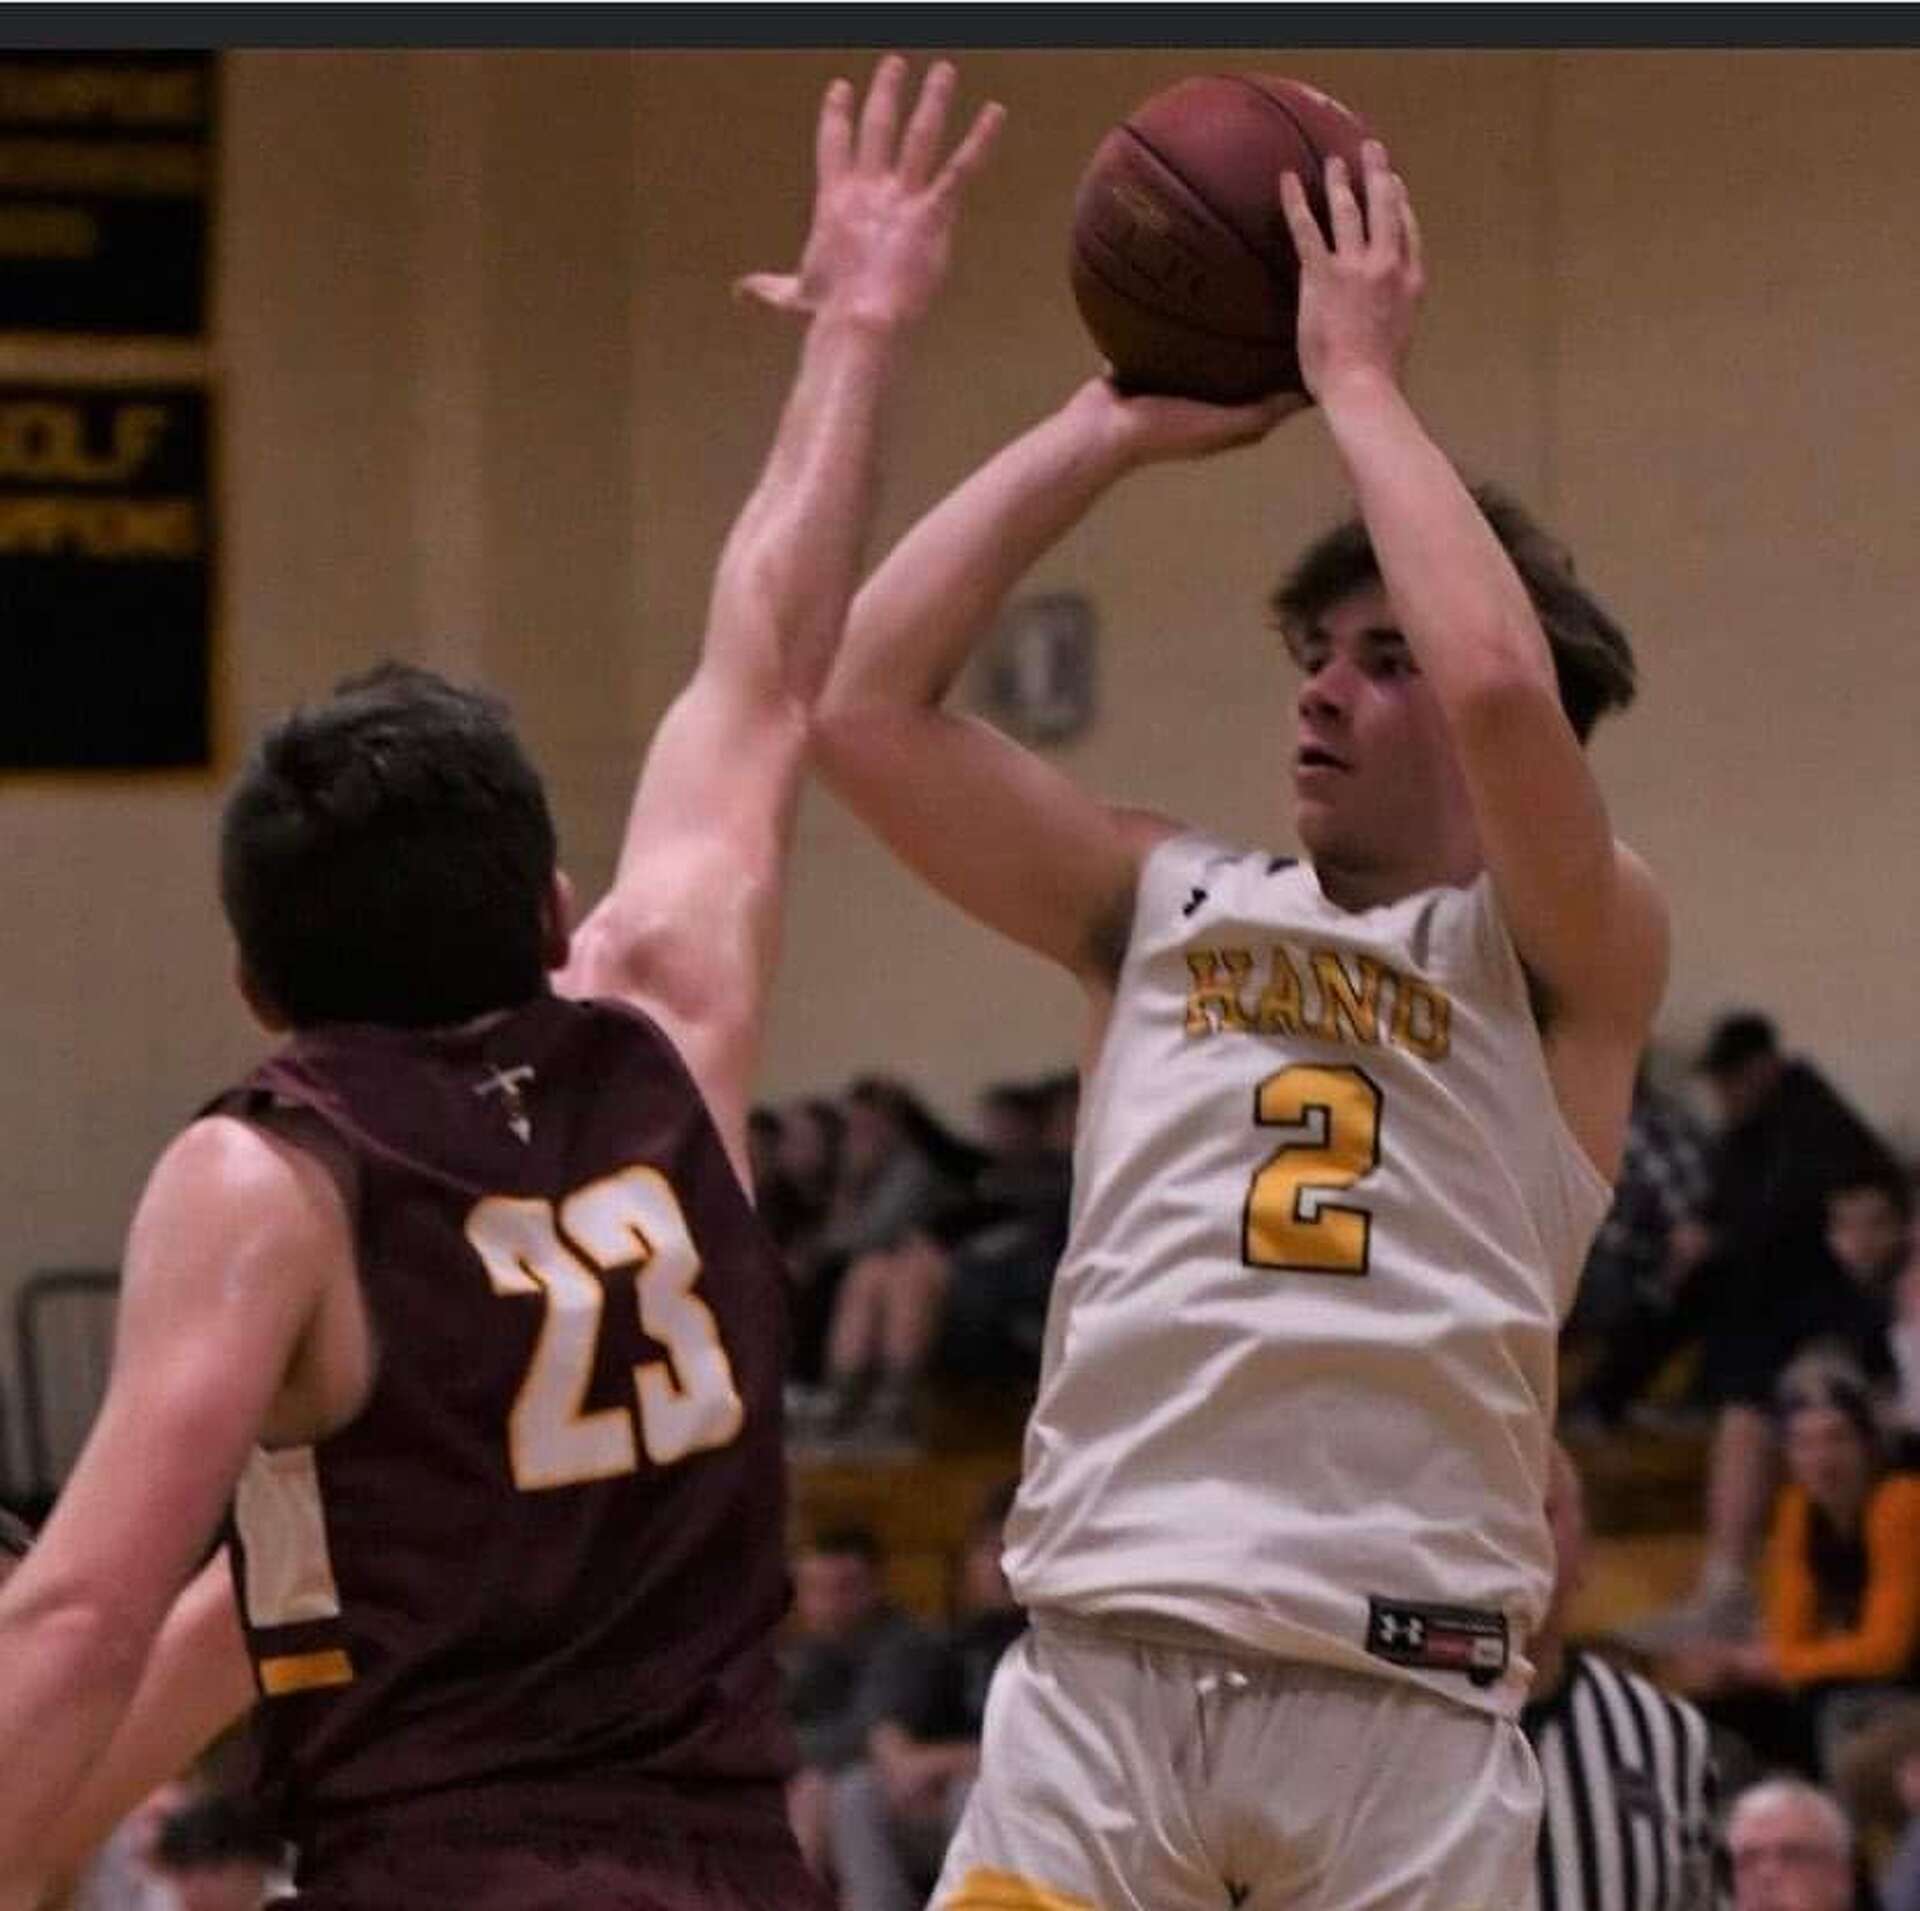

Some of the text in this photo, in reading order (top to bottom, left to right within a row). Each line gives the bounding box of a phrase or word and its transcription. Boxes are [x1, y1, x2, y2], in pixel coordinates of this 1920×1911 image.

[1185, 945, 1451, 1063] HAND
[1242, 1063, 1384, 1276] 2
[463, 1162, 744, 1493] 23
